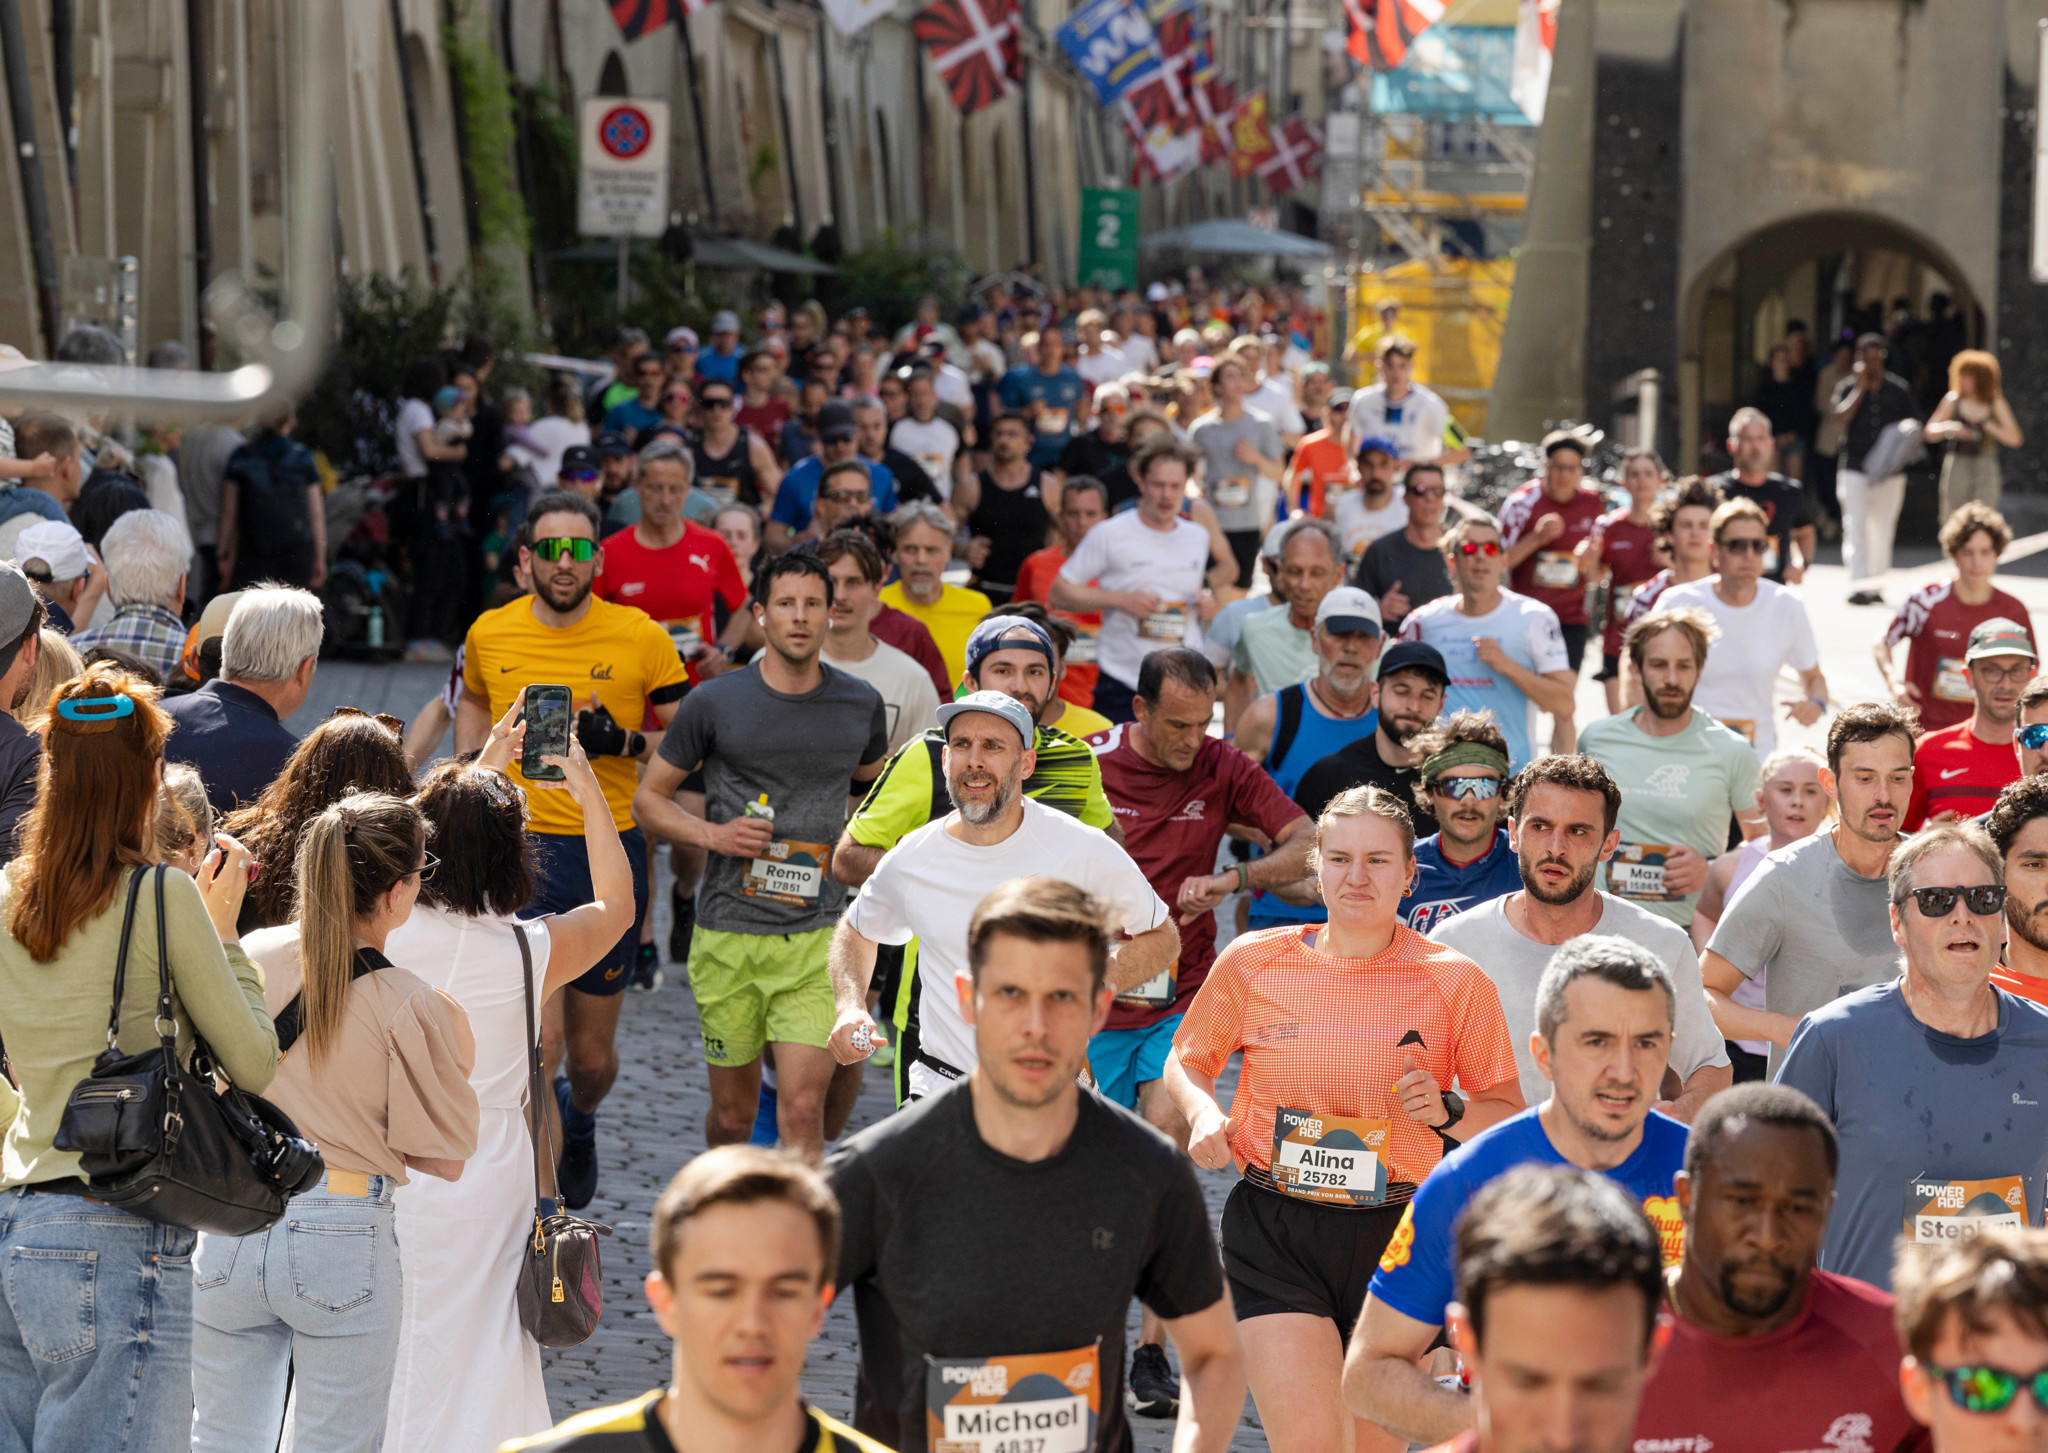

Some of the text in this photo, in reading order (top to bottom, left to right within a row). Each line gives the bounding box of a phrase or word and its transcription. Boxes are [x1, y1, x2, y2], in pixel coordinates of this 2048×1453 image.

[1095, 213, 1121, 248] 2
[590, 663, 614, 680] Cal
[766, 864, 811, 882] Remo
[1630, 867, 1660, 880] Max
[772, 880, 800, 893] 17851
[1283, 1113, 1323, 1130] POWER
[1299, 1126, 1322, 1139] ADE
[1299, 1149, 1354, 1170] Alina
[1288, 1174, 1296, 1184] H
[1302, 1170, 1347, 1186] 25782
[1287, 1186, 1307, 1195] GRAND
[1916, 1184, 1965, 1197] POWER
[1937, 1196, 1965, 1208] ADE
[942, 1364, 1008, 1384] POWER
[971, 1381, 1009, 1397] ADE
[958, 1403, 1077, 1434] Michael
[994, 1438, 1046, 1453] 4837
